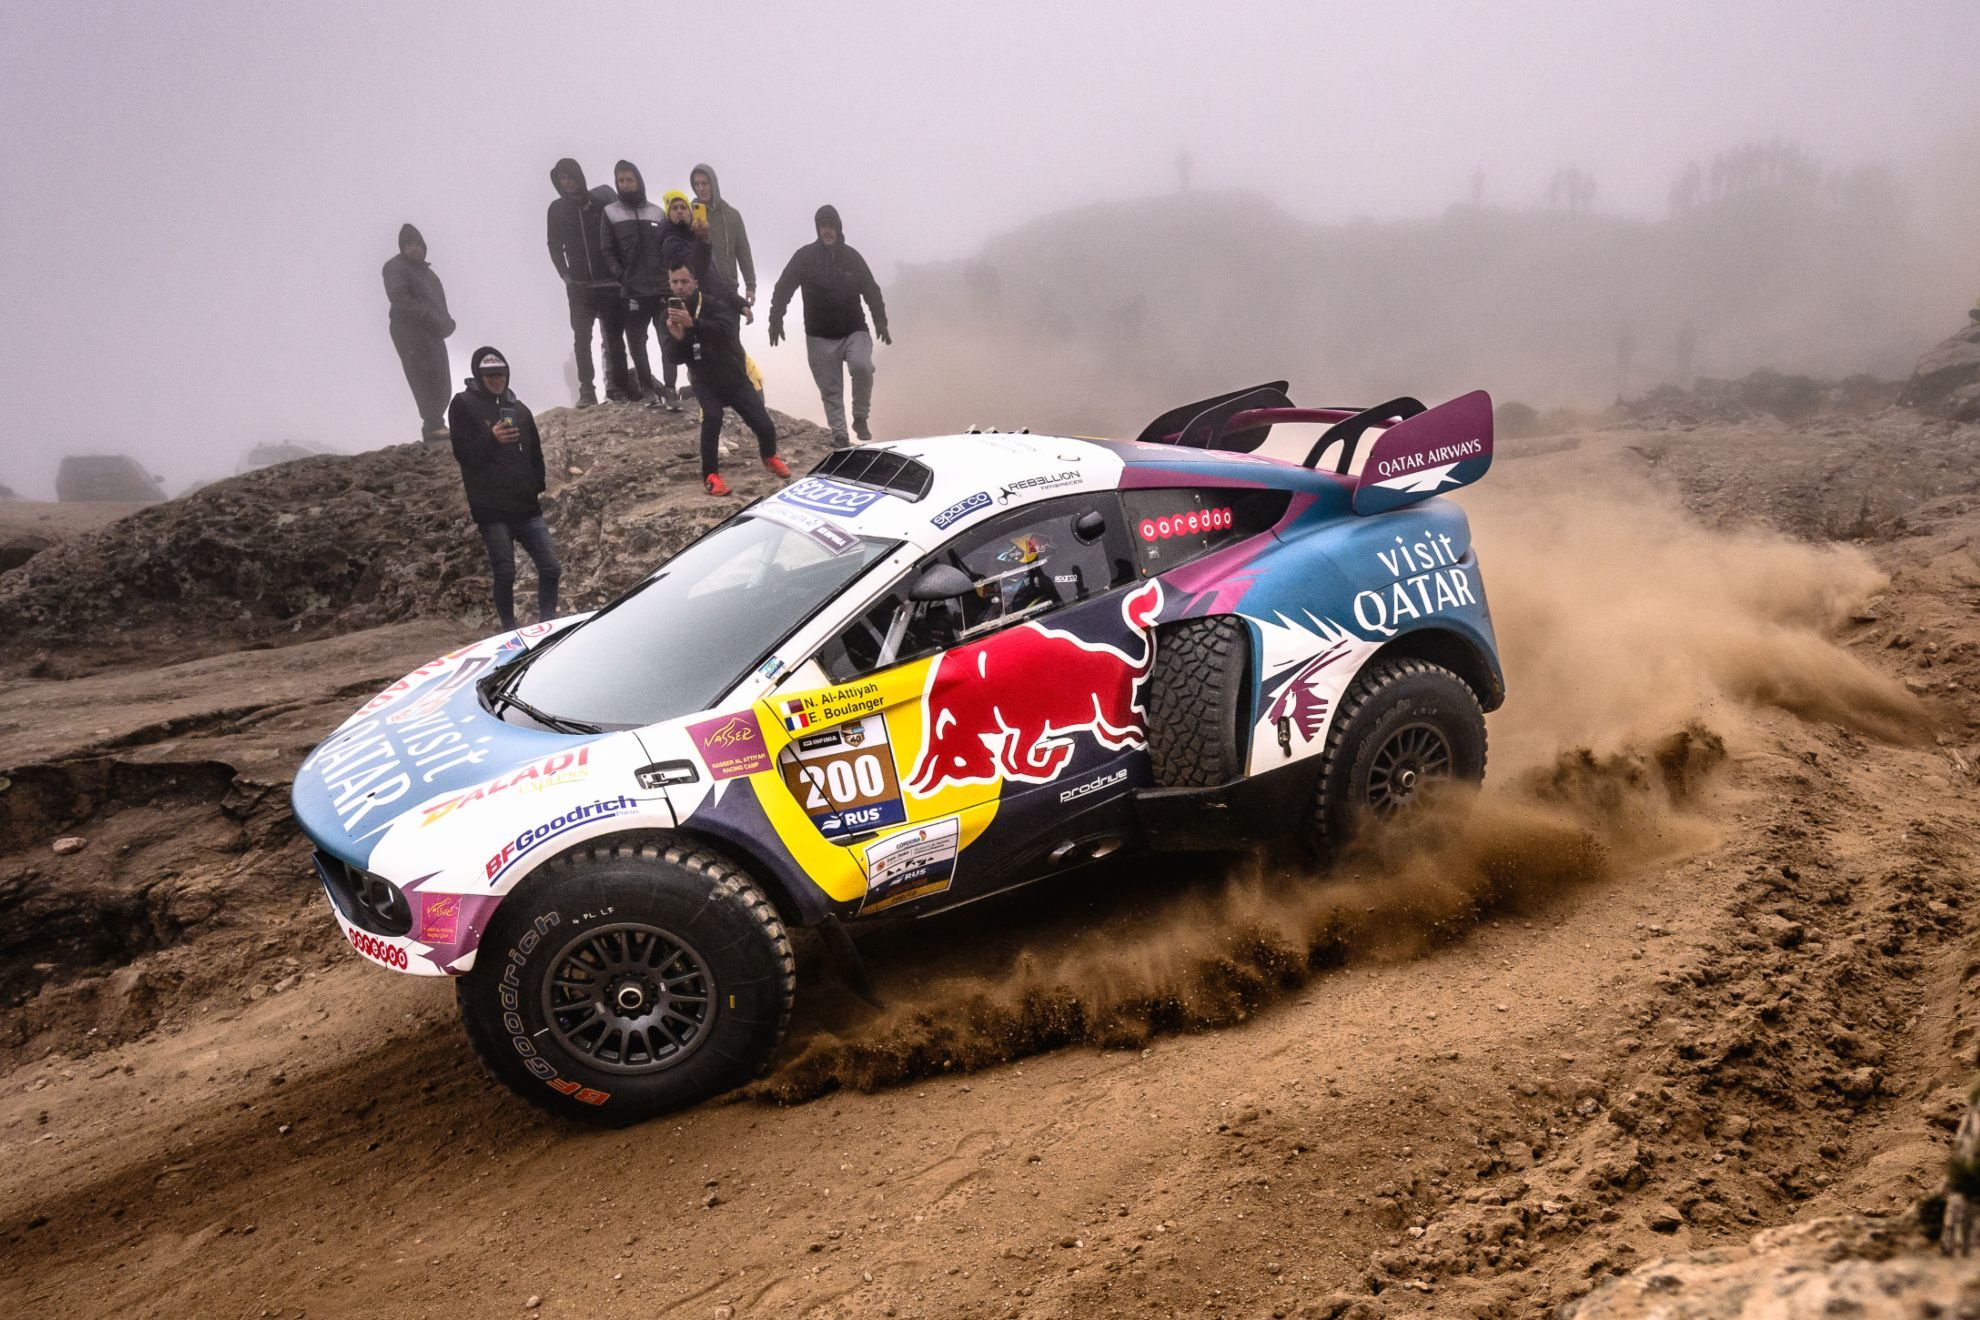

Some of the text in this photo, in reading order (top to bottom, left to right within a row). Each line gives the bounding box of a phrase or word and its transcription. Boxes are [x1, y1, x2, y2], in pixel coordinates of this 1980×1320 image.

[1378, 438, 1482, 477] QATAR AIRWAYS
[1008, 470, 1081, 491] REBELLION
[933, 493, 988, 523] sparco
[1142, 509, 1231, 537] ooredoo
[1376, 530, 1459, 577] visit
[1353, 568, 1476, 637] QATAR
[804, 683, 878, 709] N. Al-Attiyah
[808, 696, 885, 723] E. Boulanger
[397, 710, 493, 784] visit
[303, 720, 411, 832] QATAR
[800, 754, 885, 809] 200
[1060, 768, 1128, 803] prodrive
[844, 807, 881, 826] RUS
[485, 795, 638, 881] BFGoodrich
[904, 868, 927, 880] RUS
[349, 929, 407, 968] ooredoo
[498, 911, 611, 1106] BFGoodrich
